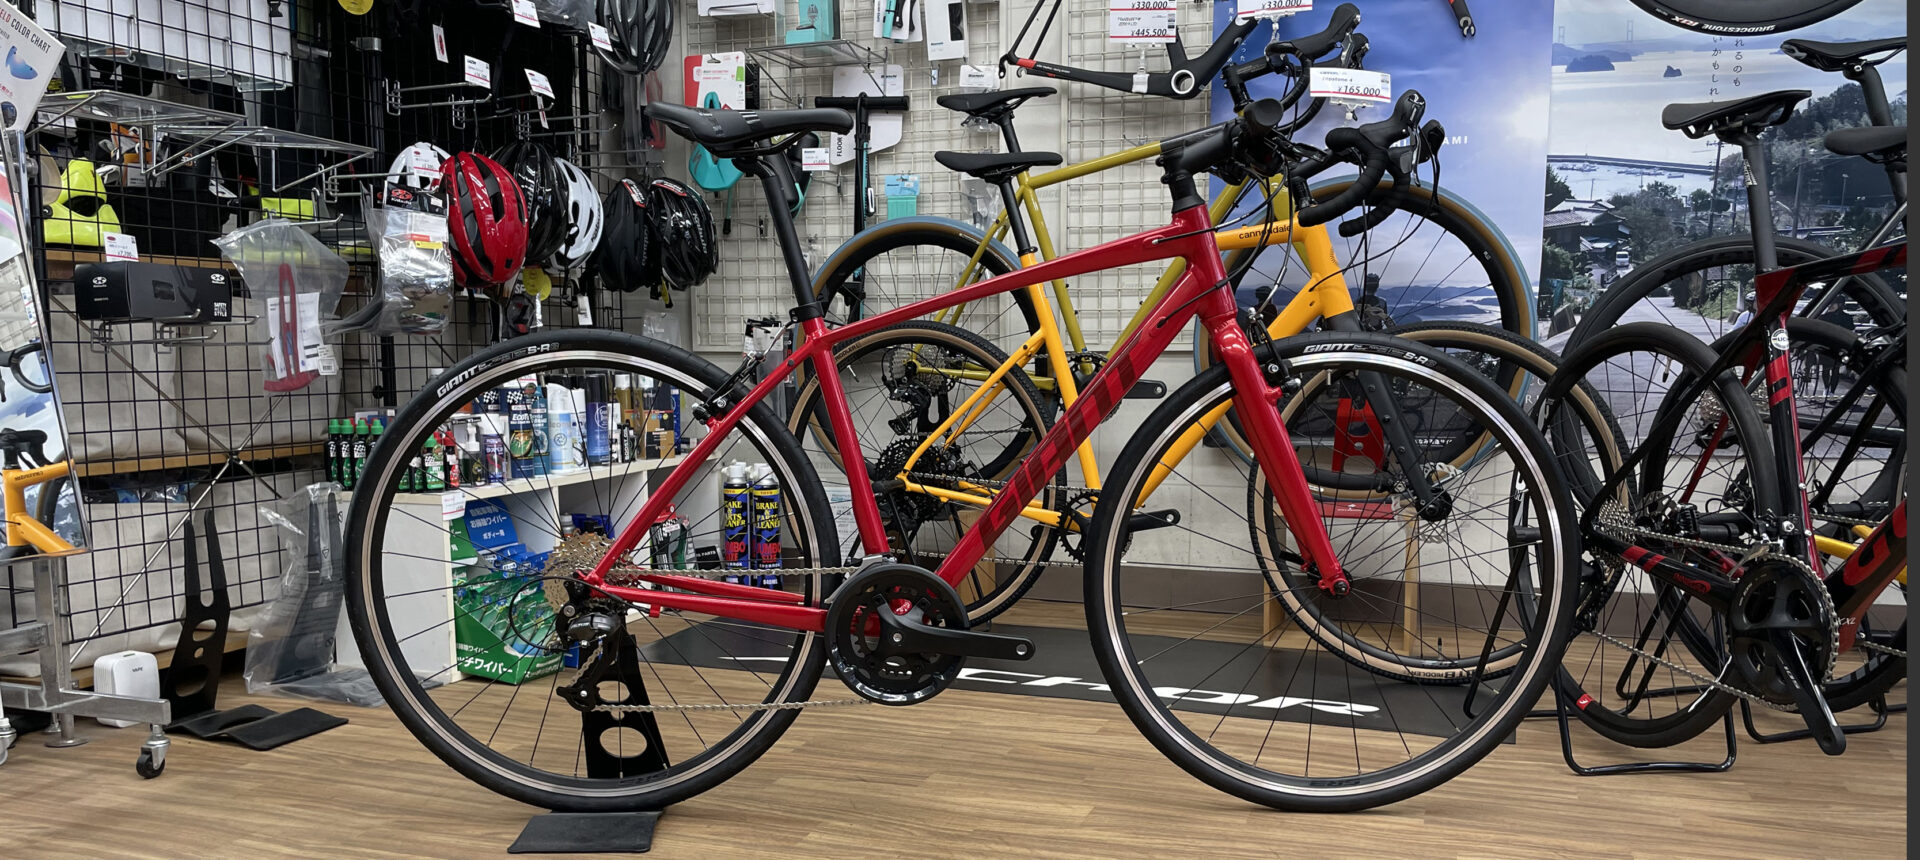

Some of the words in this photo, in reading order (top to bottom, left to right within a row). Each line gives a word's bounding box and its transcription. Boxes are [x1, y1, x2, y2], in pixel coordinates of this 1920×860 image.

[1131, 28, 1167, 37] ¥445,500
[1701, 23, 1776, 33] BRIDGESTONE
[11, 18, 31, 39] COLOR
[31, 33, 51, 54] CHART
[1733, 39, 1745, 87] れるのも
[1709, 36, 1722, 103] いかもしれ
[1338, 85, 1381, 96] ¥165,000
[1239, 224, 1292, 239] canndale
[1303, 343, 1355, 353] GIANT
[437, 364, 479, 398] GIANT
[756, 502, 778, 510] BRAKE
[756, 520, 781, 529] LEANE
